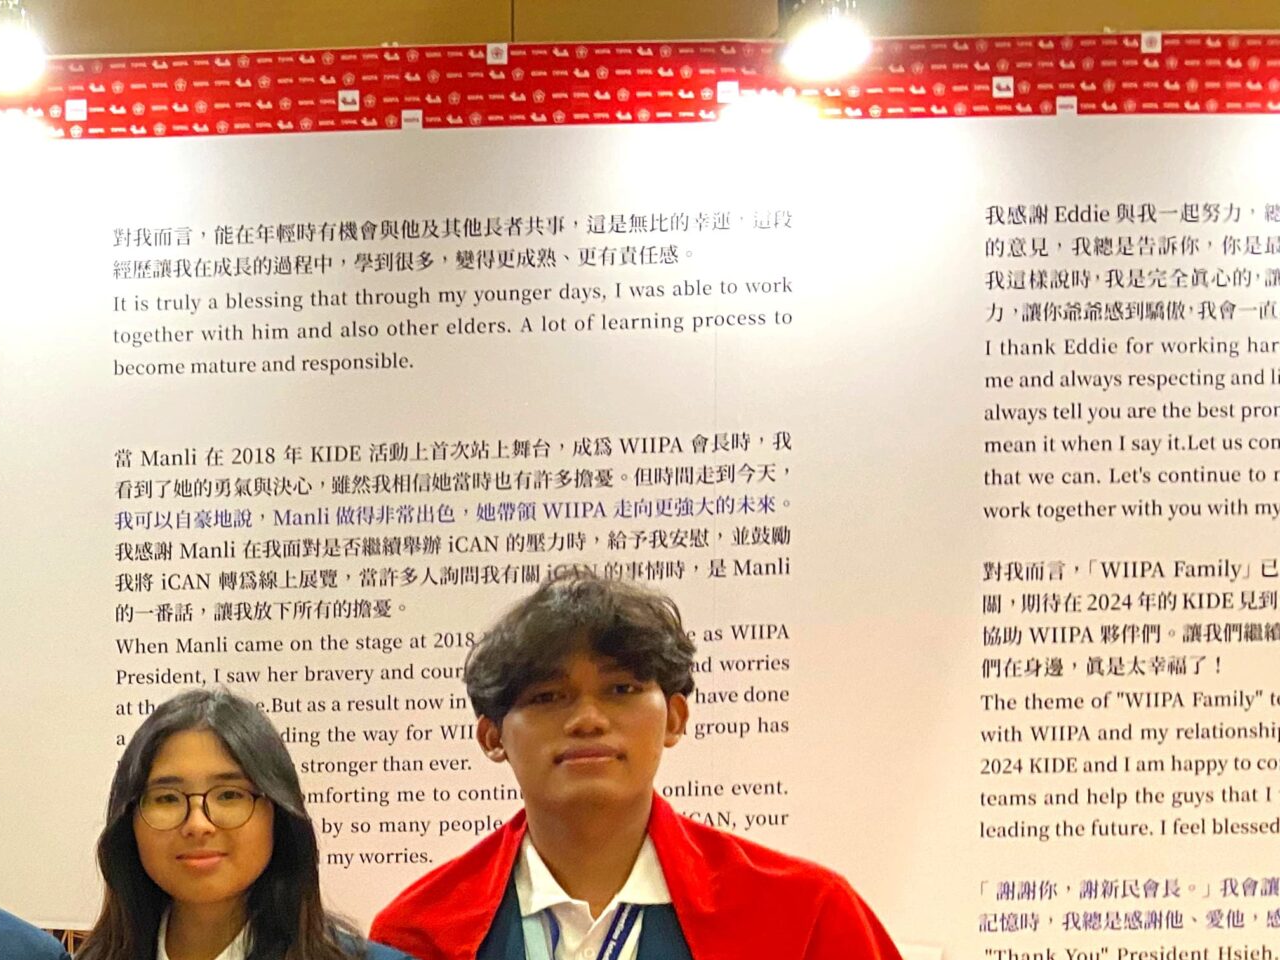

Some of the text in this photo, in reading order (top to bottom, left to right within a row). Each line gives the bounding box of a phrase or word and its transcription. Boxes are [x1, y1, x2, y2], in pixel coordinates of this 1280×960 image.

[114, 311, 792, 347] together with him and also other elders. A lot of learning process to
[986, 336, 1239, 358] I thank Eddie for working
[114, 352, 413, 375] become mature and responsible.
[984, 498, 1248, 522] work together with you with
[115, 541, 172, 561] 我感謝
[180, 541, 235, 559] Manli
[448, 536, 499, 553] iCAN
[116, 599, 405, 623] 的一番話，讓我放下所有的擔憂。
[981, 723, 1168, 745] with WIIPA and my
[301, 756, 471, 777] stronger than ever.
[663, 781, 788, 797] online event.
[981, 818, 1205, 841] leading the future. I feel
[328, 848, 432, 869] my worries.
[1219, 944, 1278, 960] Hsieh.
